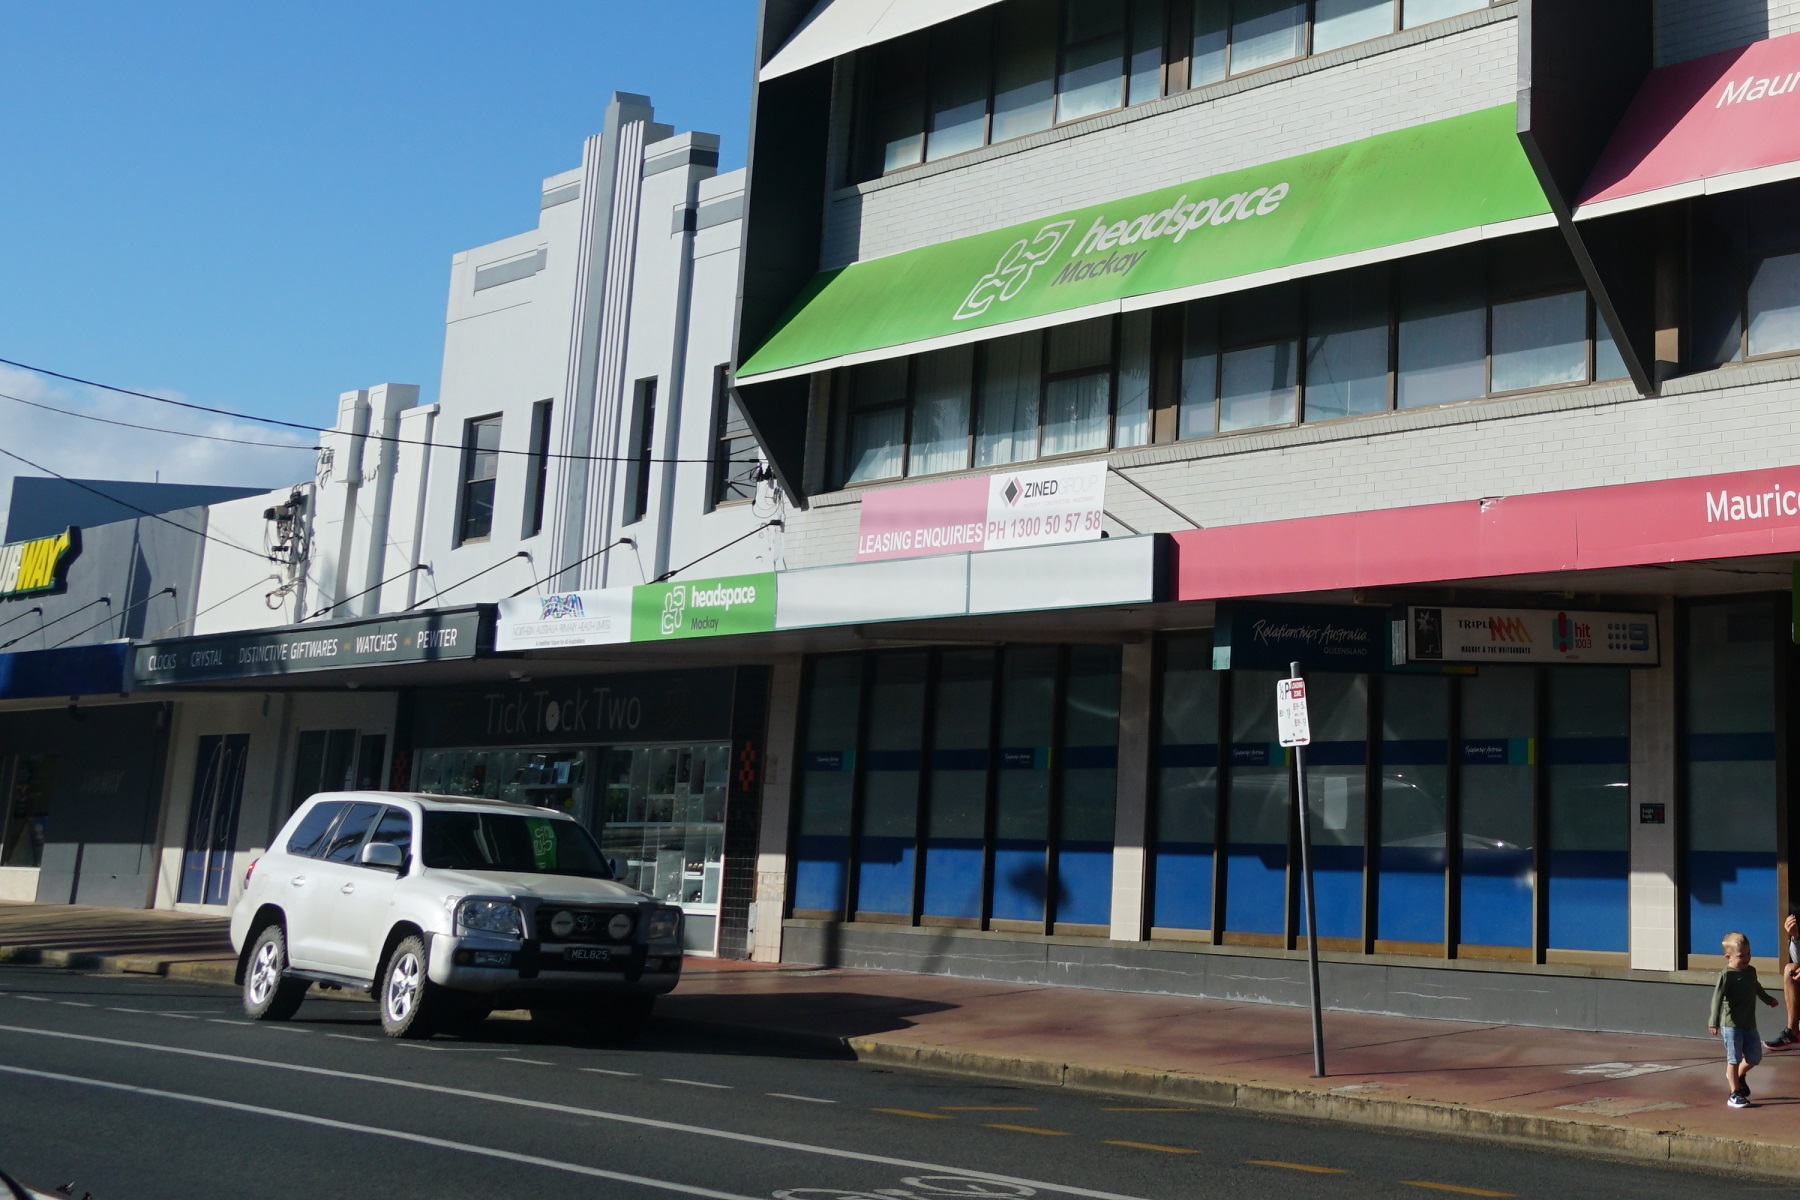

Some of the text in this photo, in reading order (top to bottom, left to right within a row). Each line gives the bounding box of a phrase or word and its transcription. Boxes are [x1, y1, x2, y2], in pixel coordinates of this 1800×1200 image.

[1071, 182, 1290, 258] headspace
[1051, 250, 1147, 287] Mackay
[858, 510, 1102, 555] LEASING ENQUIRIES PH 1300 50 57 58
[691, 583, 756, 611] headspace
[691, 616, 719, 631] Mackay
[1252, 618, 1367, 646] Relationships Australia
[1574, 622, 1591, 638] hit
[148, 628, 457, 671] CLOCKS CRYSTAL DISTINCTIVE GIFTWARES WATCHES PEWTER
[1323, 647, 1367, 656] QUEENSLAND
[484, 687, 641, 735] Tick Tock Two
[571, 949, 608, 959] MEL825
